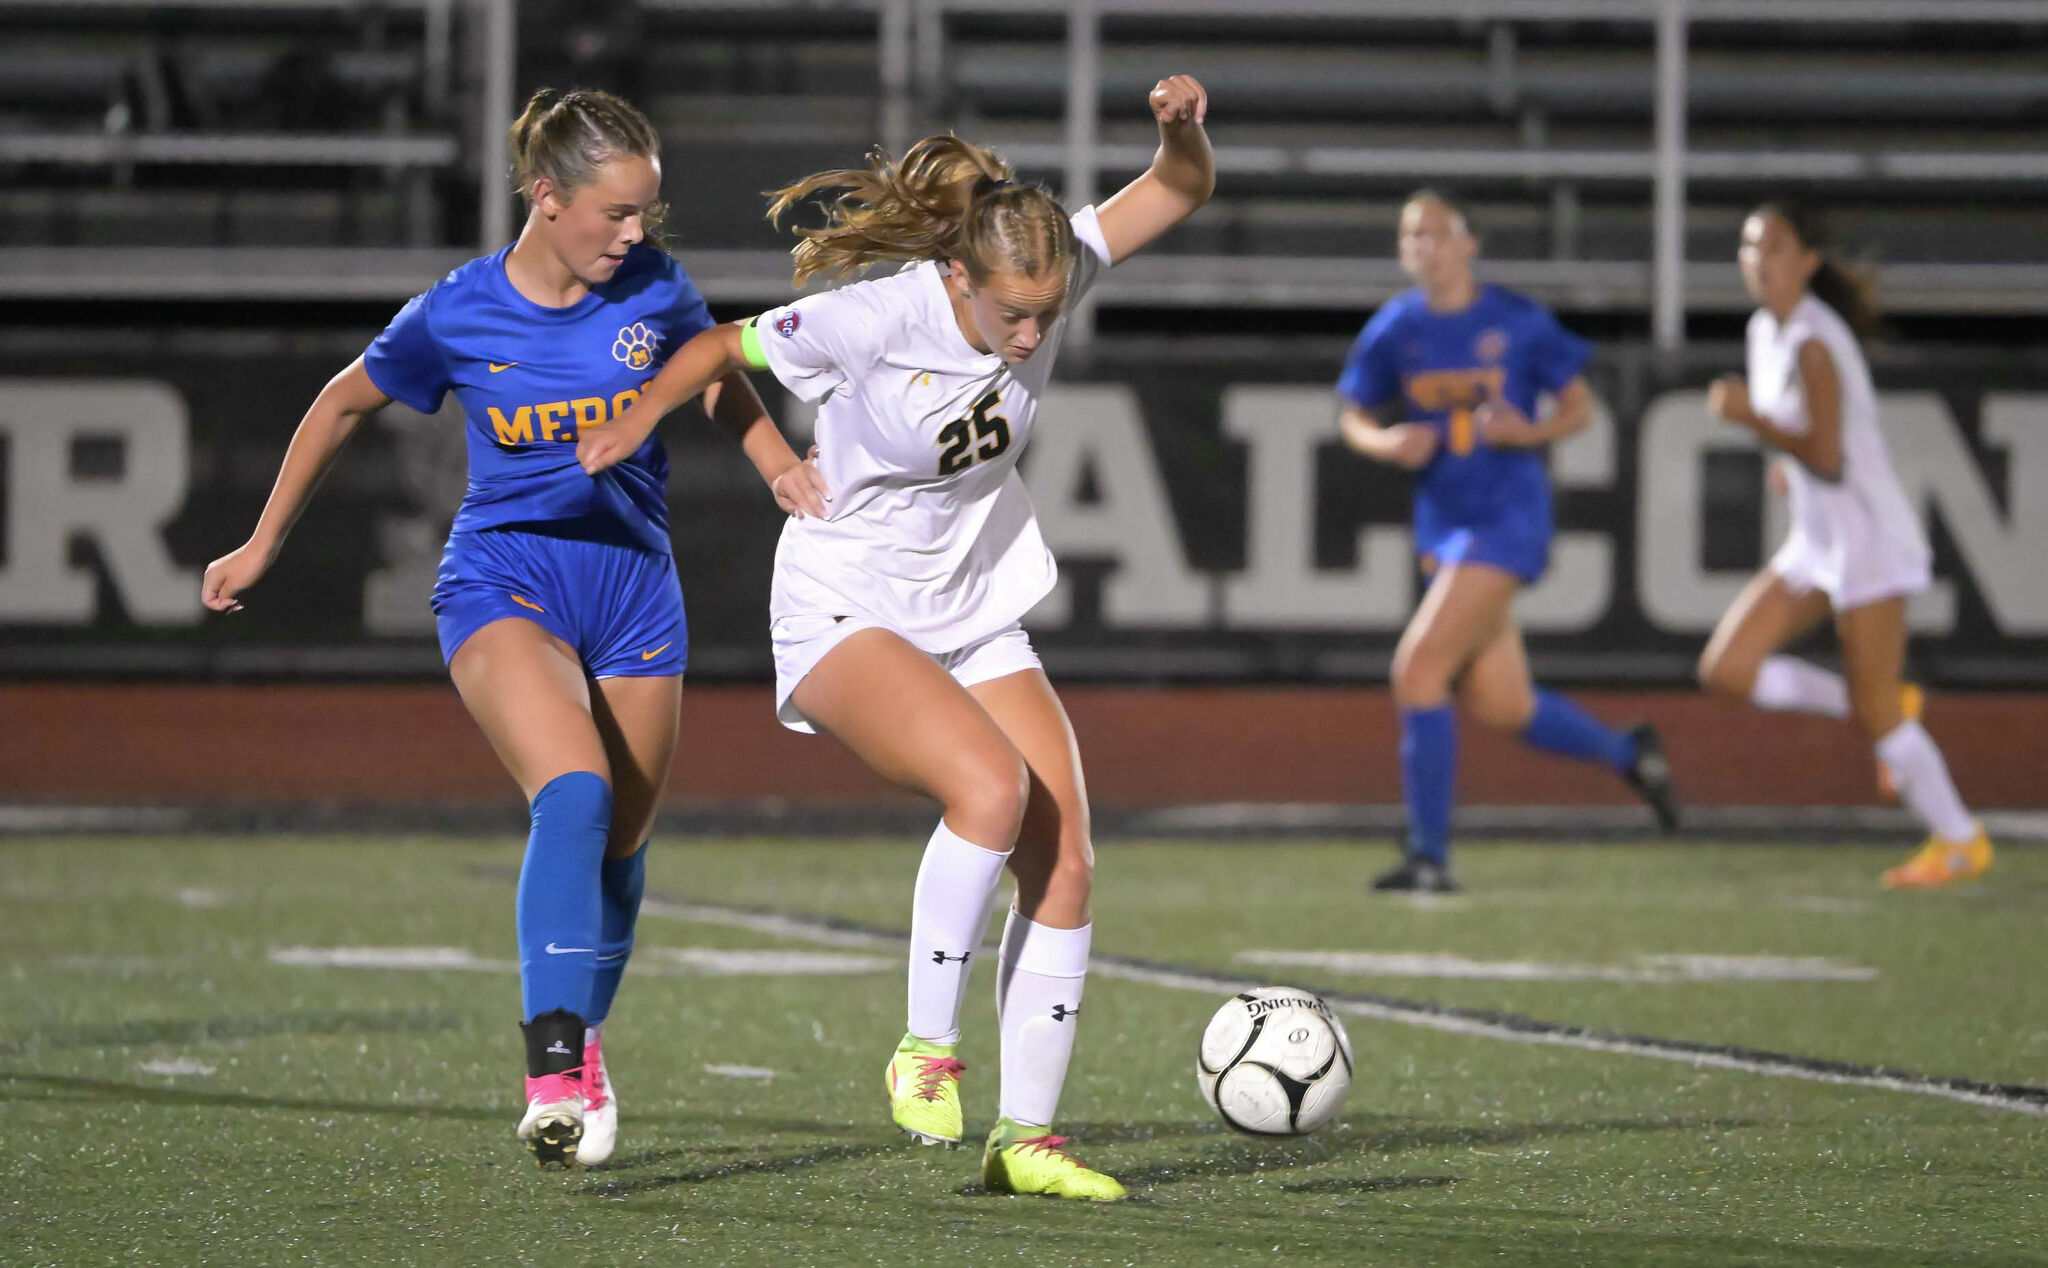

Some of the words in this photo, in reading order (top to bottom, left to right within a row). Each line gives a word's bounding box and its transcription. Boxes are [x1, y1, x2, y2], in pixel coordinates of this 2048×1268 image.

[631, 348, 649, 366] M
[487, 380, 651, 446] MER
[937, 389, 1012, 476] 25
[0, 376, 206, 627] R
[785, 378, 2048, 630] ALON
